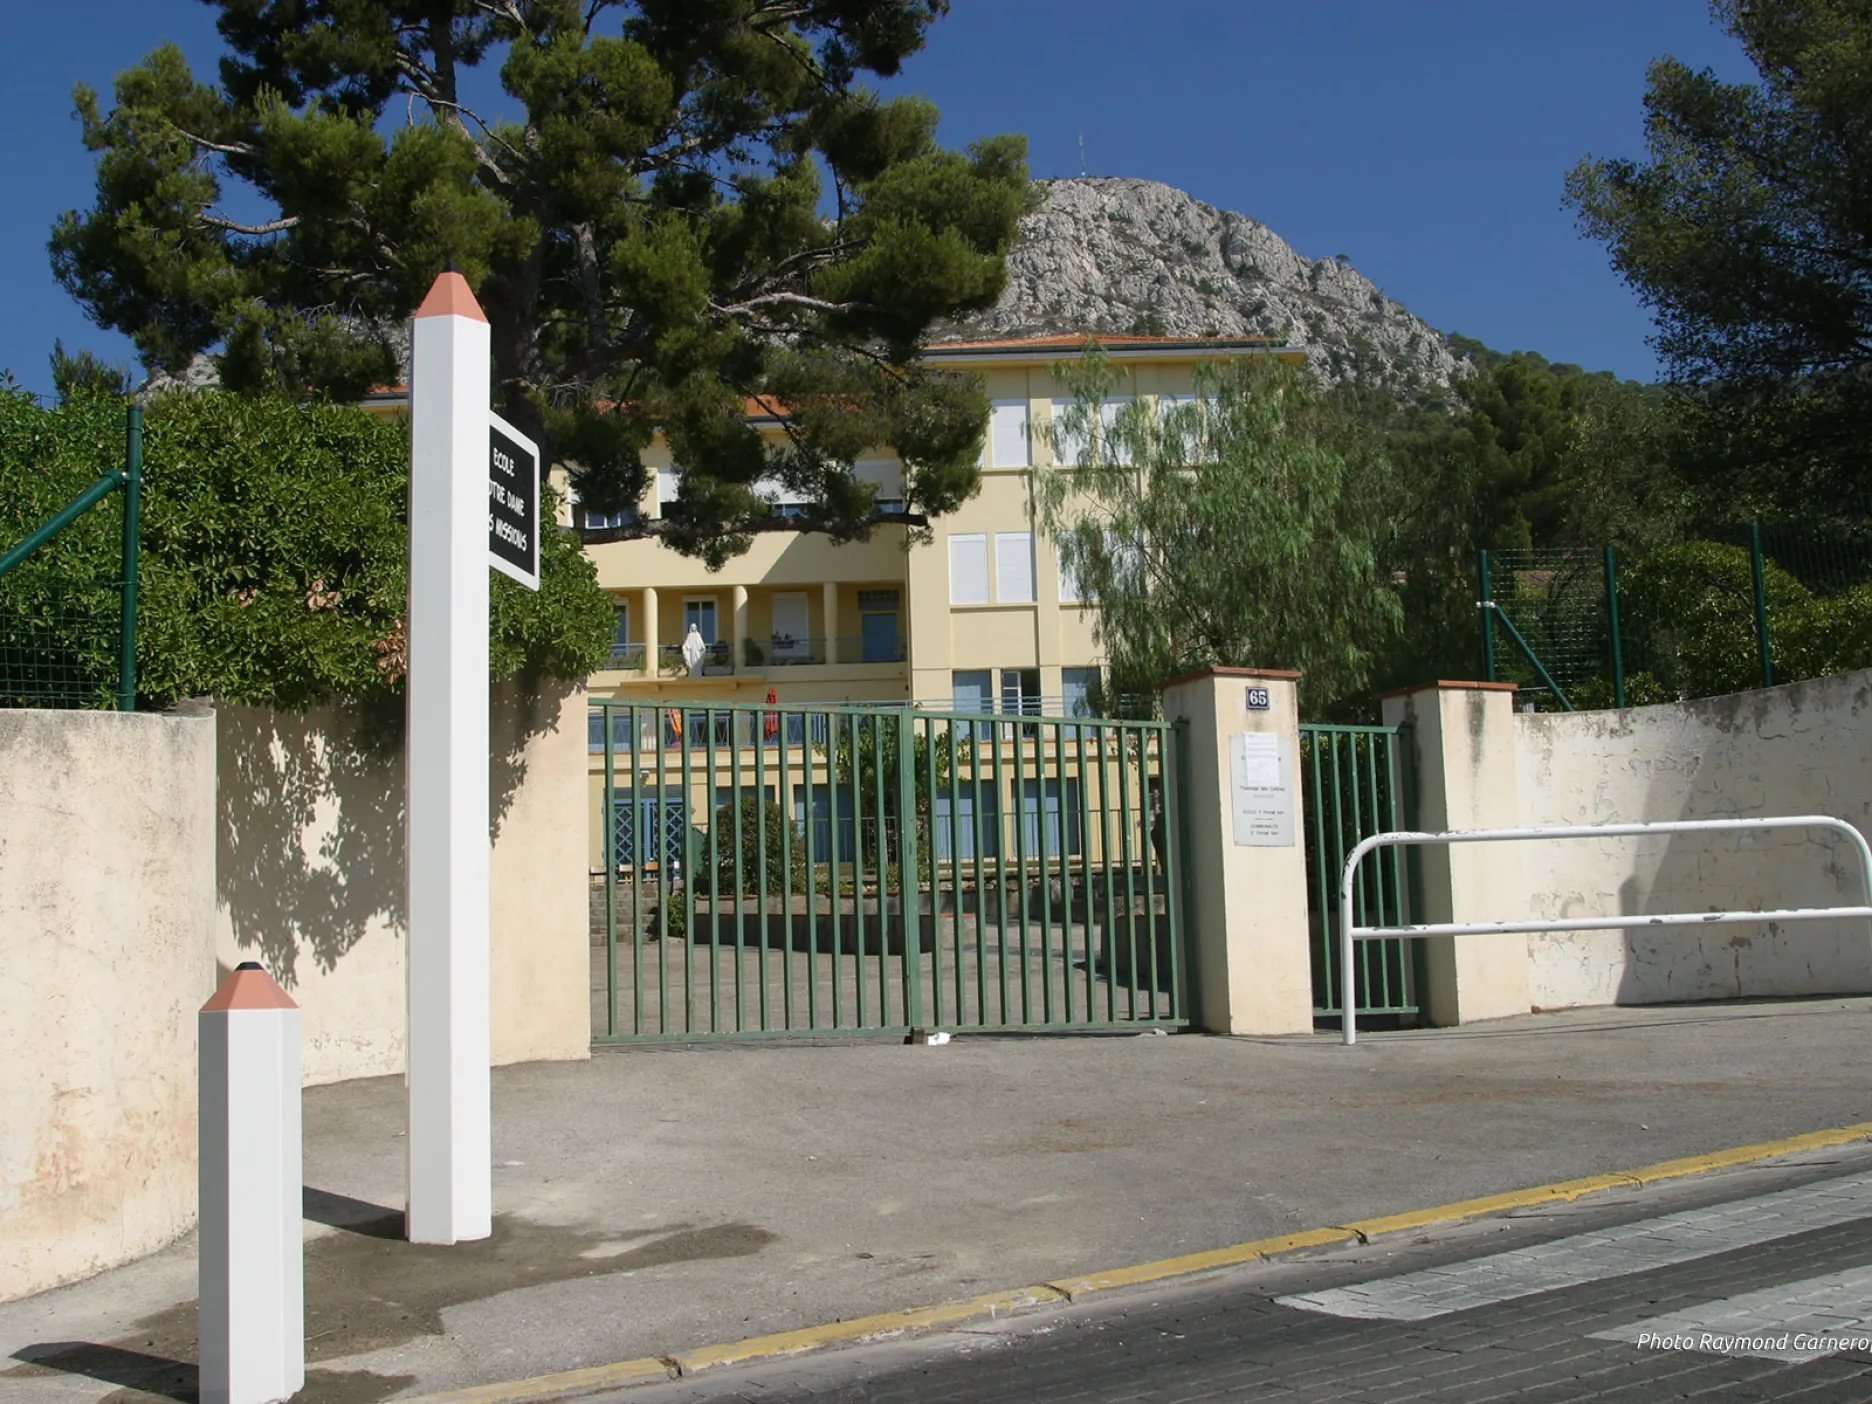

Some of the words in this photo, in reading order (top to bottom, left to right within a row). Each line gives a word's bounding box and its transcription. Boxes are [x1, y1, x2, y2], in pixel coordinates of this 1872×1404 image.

[493, 447, 516, 477] ECOLE
[489, 479, 506, 505] OTRE
[1250, 690, 1267, 705] 65
